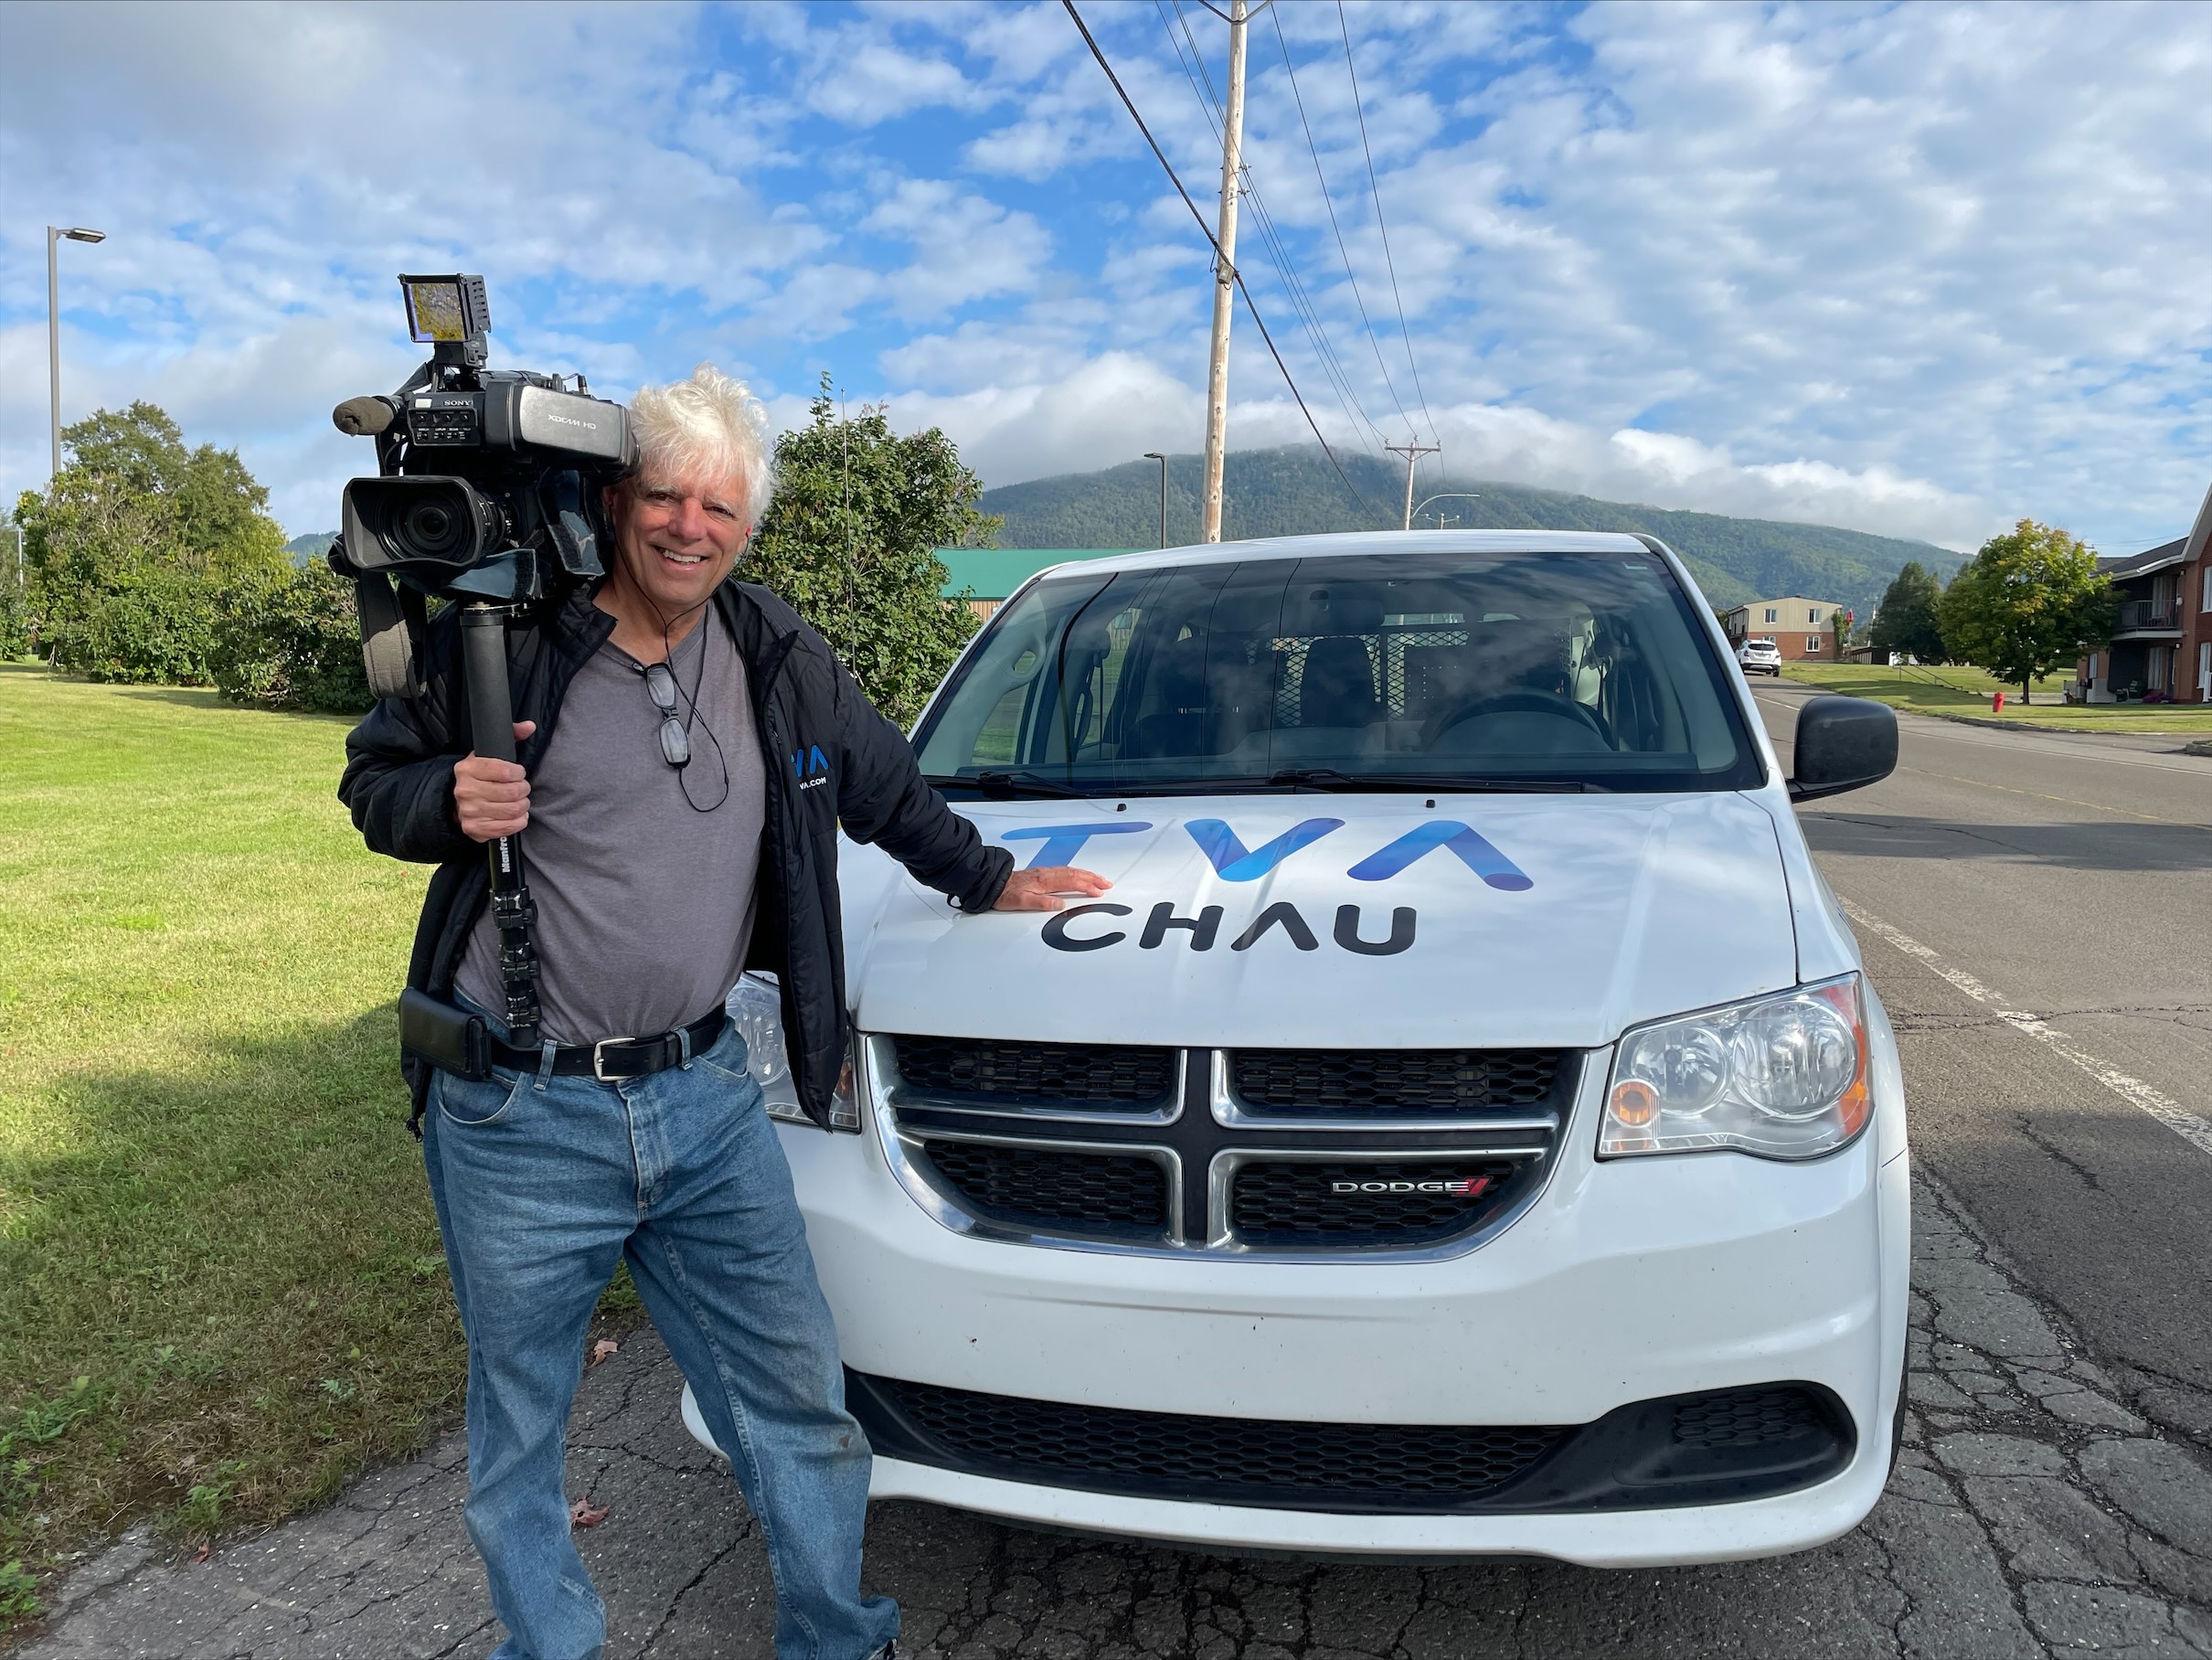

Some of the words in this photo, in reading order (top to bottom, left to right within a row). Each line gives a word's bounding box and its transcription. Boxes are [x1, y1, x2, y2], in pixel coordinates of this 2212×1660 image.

[548, 414, 580, 427] XDCAM
[583, 421, 596, 430] HD
[791, 745, 829, 777] VA
[799, 777, 827, 790] VA.COM
[499, 835, 511, 873] Manfro
[1000, 818, 1534, 891] TVA
[1041, 901, 1416, 956] CHAU
[1332, 1181, 1470, 1193] DODGE
